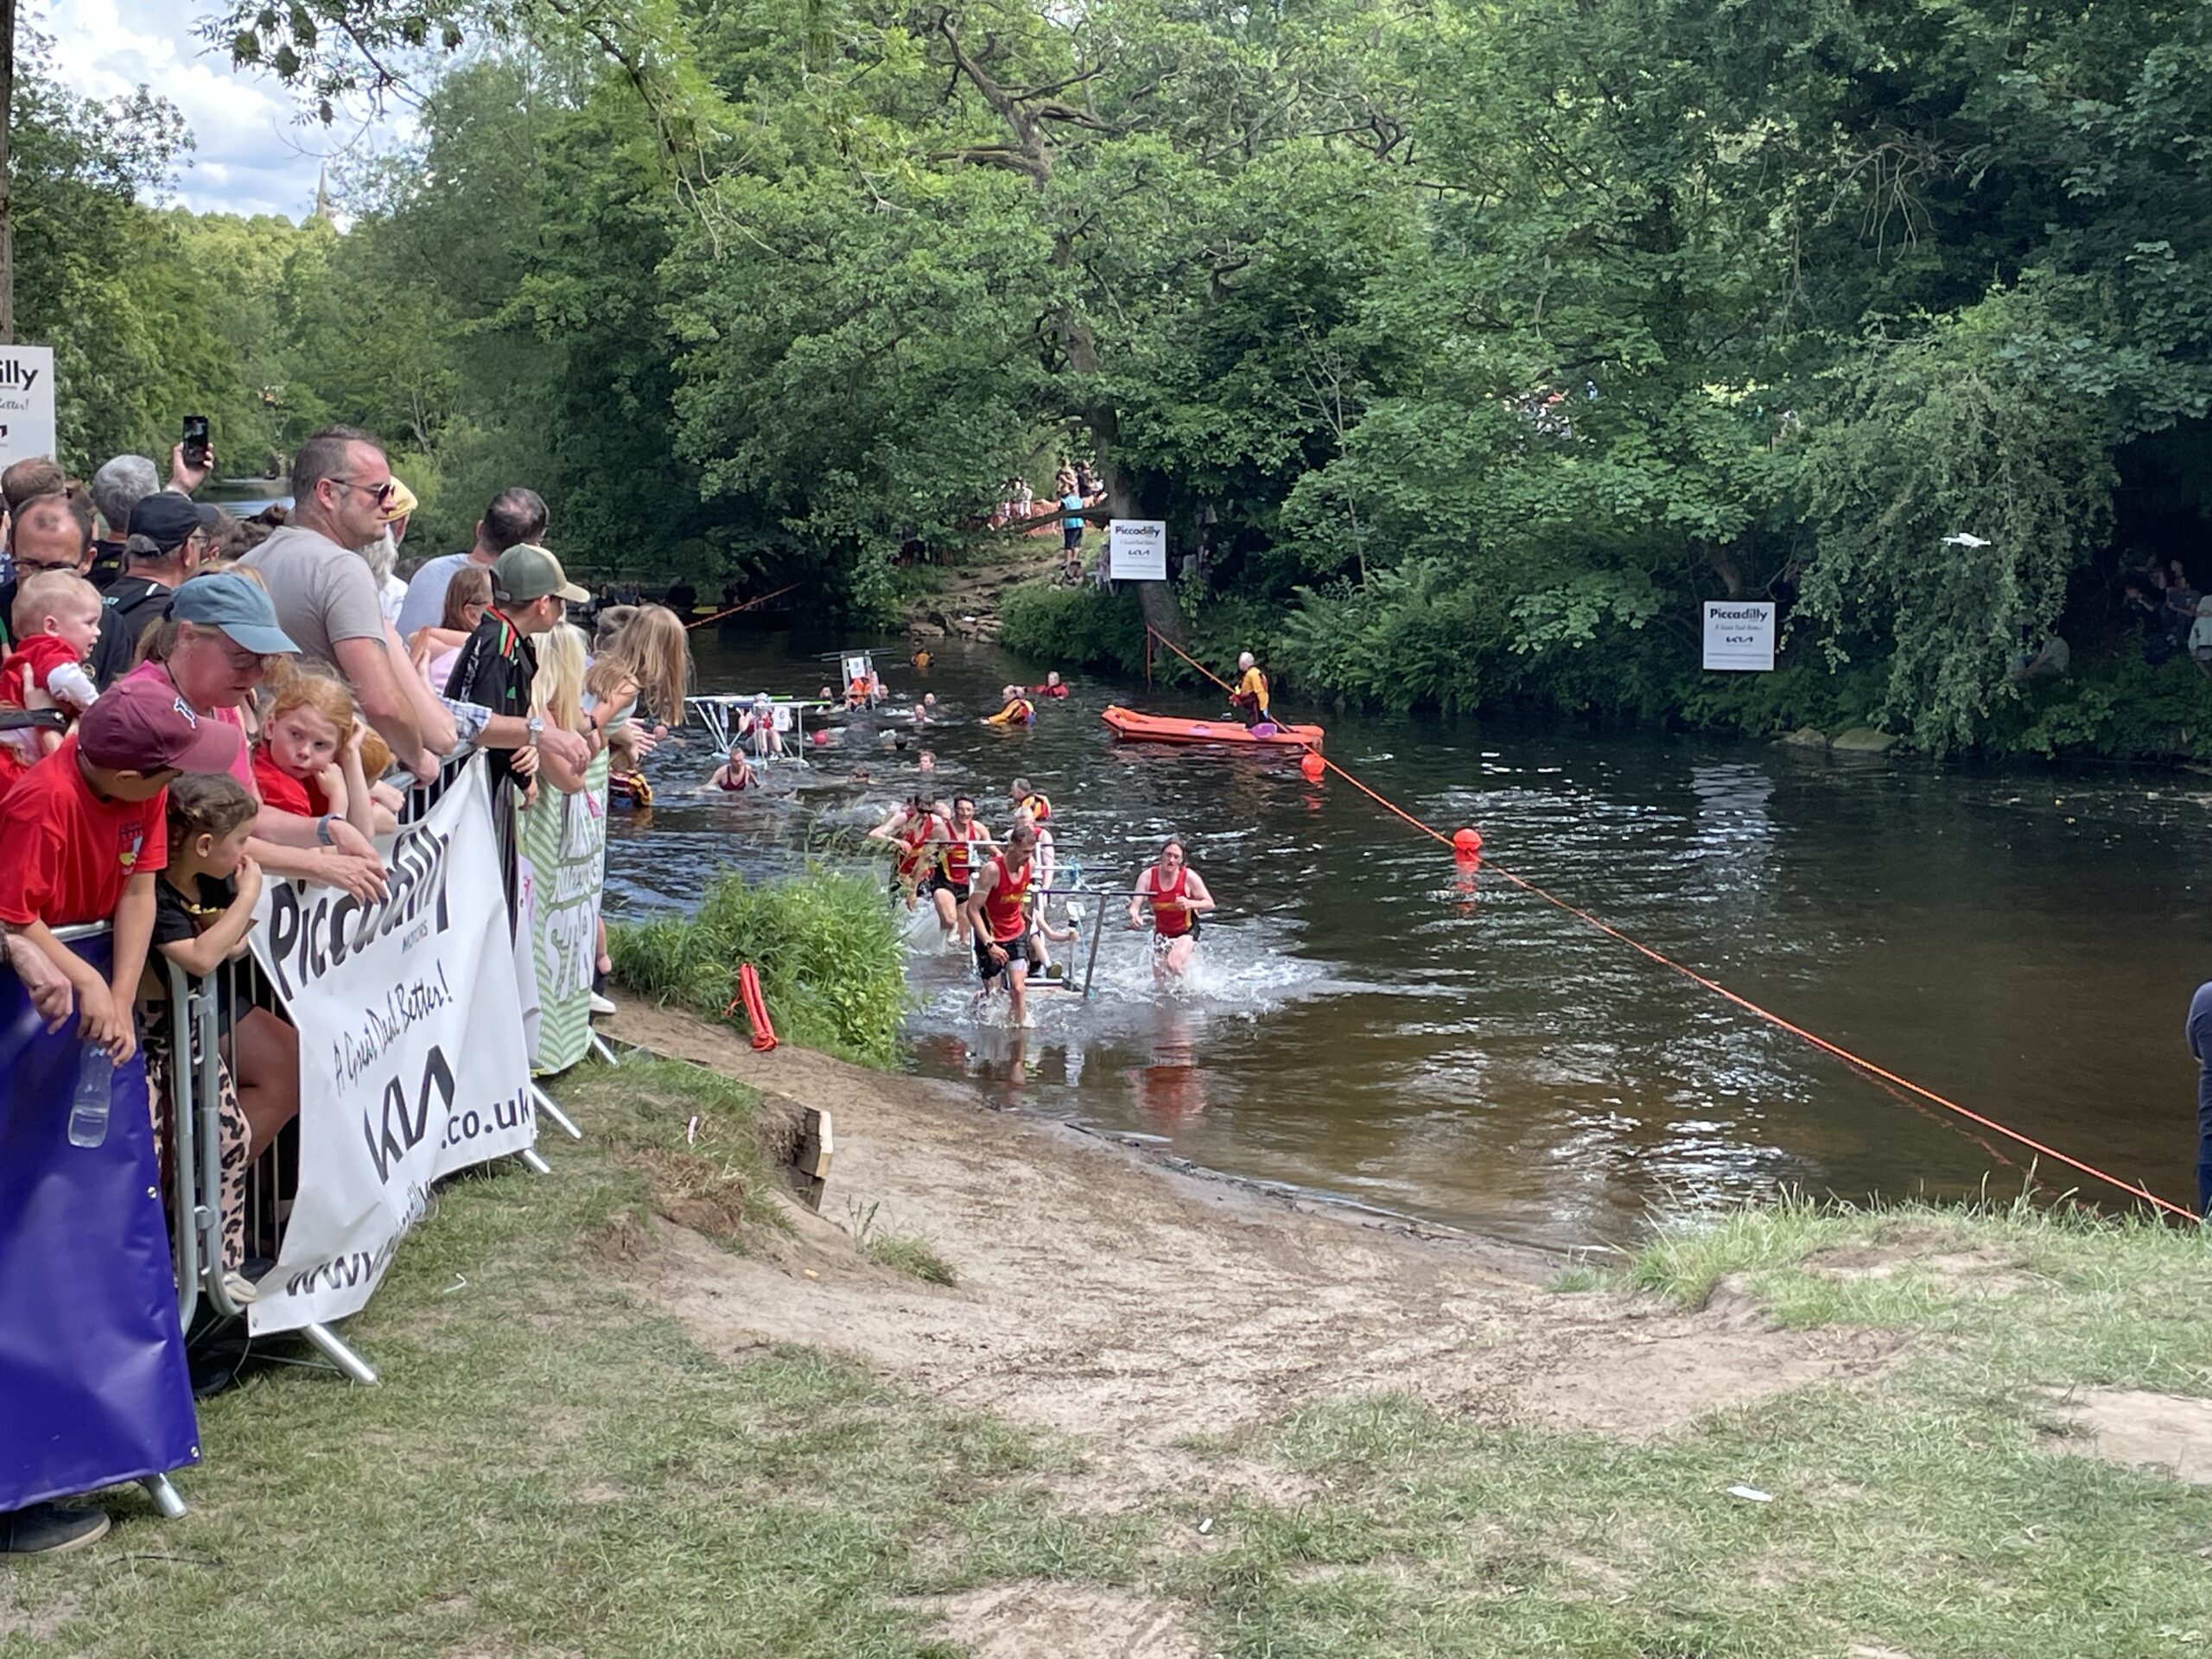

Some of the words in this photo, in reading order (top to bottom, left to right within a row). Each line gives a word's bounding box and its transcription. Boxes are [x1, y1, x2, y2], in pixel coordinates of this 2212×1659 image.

[1116, 525, 1160, 538] Piccadilly
[1710, 607, 1768, 621] Piccadilly
[334, 1039, 345, 1098] A
[365, 990, 400, 1055] Deal
[394, 957, 454, 1033] Better!
